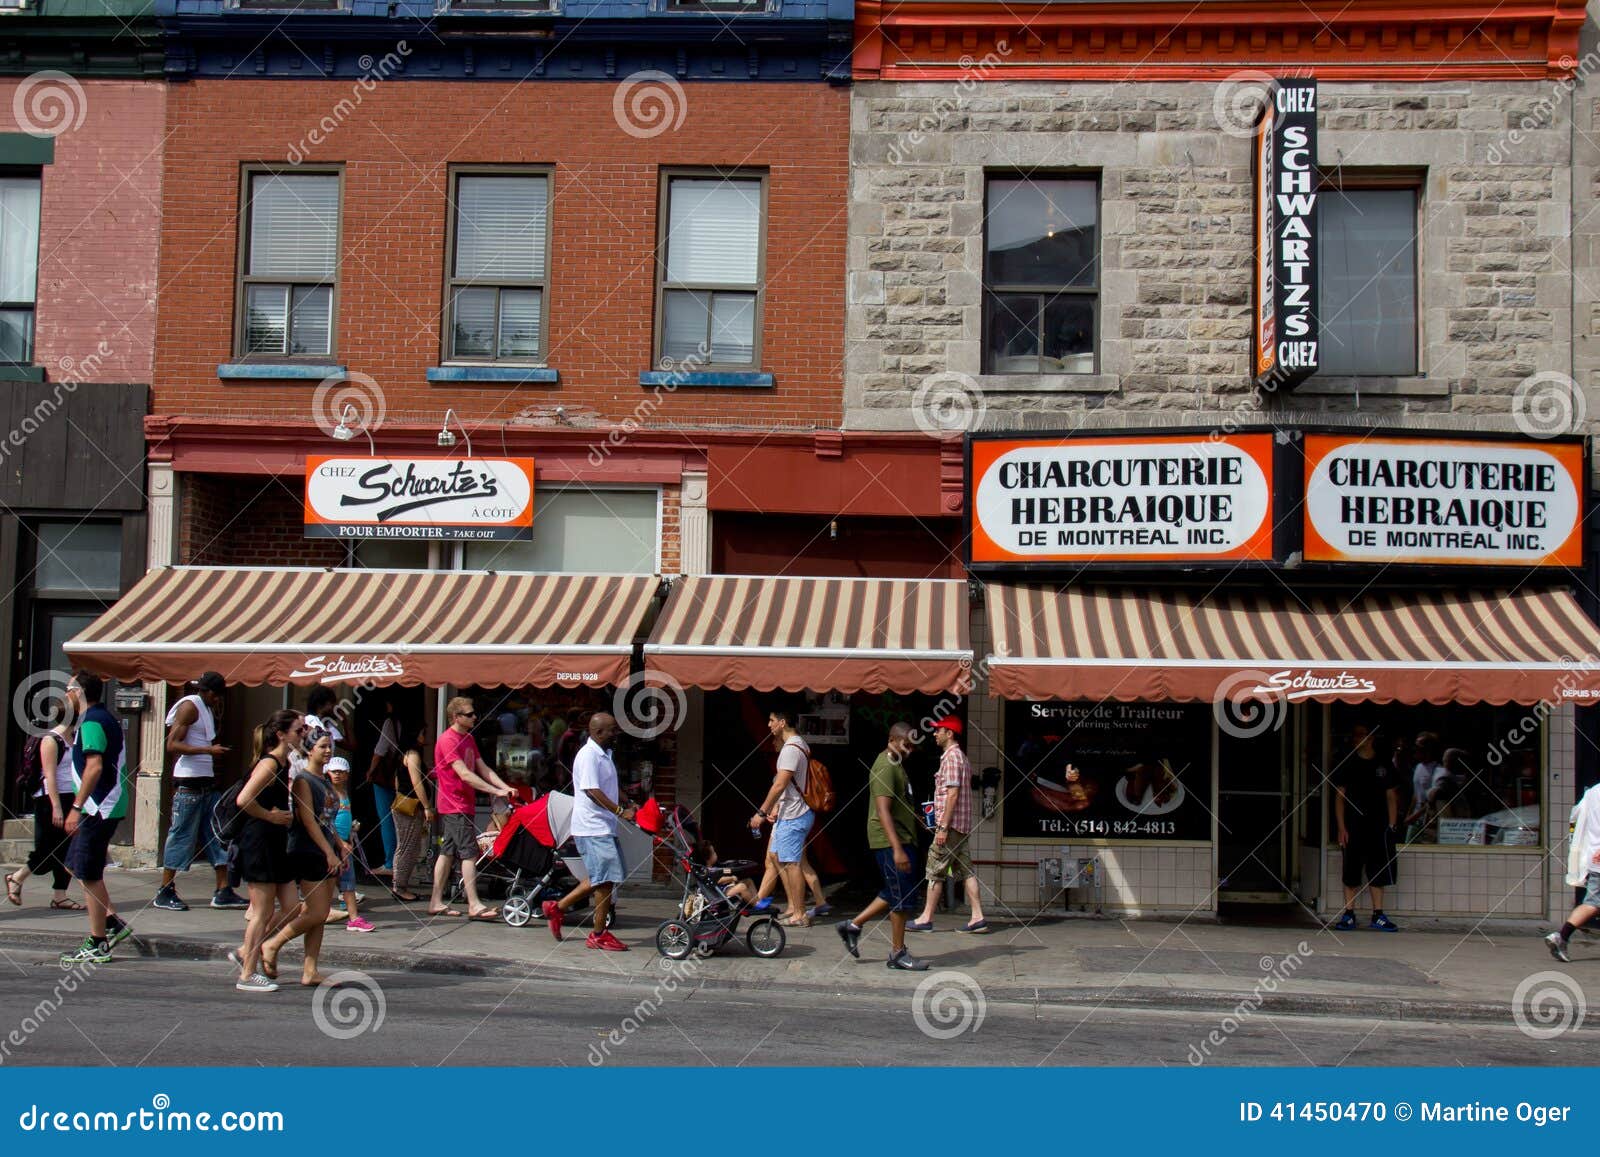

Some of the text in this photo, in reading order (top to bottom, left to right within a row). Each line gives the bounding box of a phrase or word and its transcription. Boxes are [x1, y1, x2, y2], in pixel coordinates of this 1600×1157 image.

[1277, 88, 1315, 112] CHEZ
[1277, 126, 1317, 336] SCHWARTZ'S
[1279, 341, 1317, 366] CHEZ
[320, 467, 356, 478] CHEZ
[999, 457, 1243, 489] CHARCUTERIE
[1329, 458, 1555, 492] CHARCUTERIE
[340, 460, 499, 521] Schwartz's
[471, 507, 515, 518] À CÔTÉ
[1011, 495, 1233, 527] HEBRAIQUE
[1341, 496, 1547, 532] HEBRAIQUE
[339, 526, 375, 537] POUR
[377, 527, 443, 538] EMPORTER
[453, 530, 475, 538] TAKE
[1018, 528, 1230, 546] DE MONTRÉAL INC.
[1348, 530, 1545, 550] DE MONTRÉAL INC.
[556, 672, 598, 681] DEPUIS 1928
[1562, 689, 1590, 697] DEPUIS
[1031, 704, 1185, 719] Service de Traiteur
[1067, 719, 1149, 729] Catering Service
[1039, 819, 1175, 835] Tél.: (514) 842-4813
